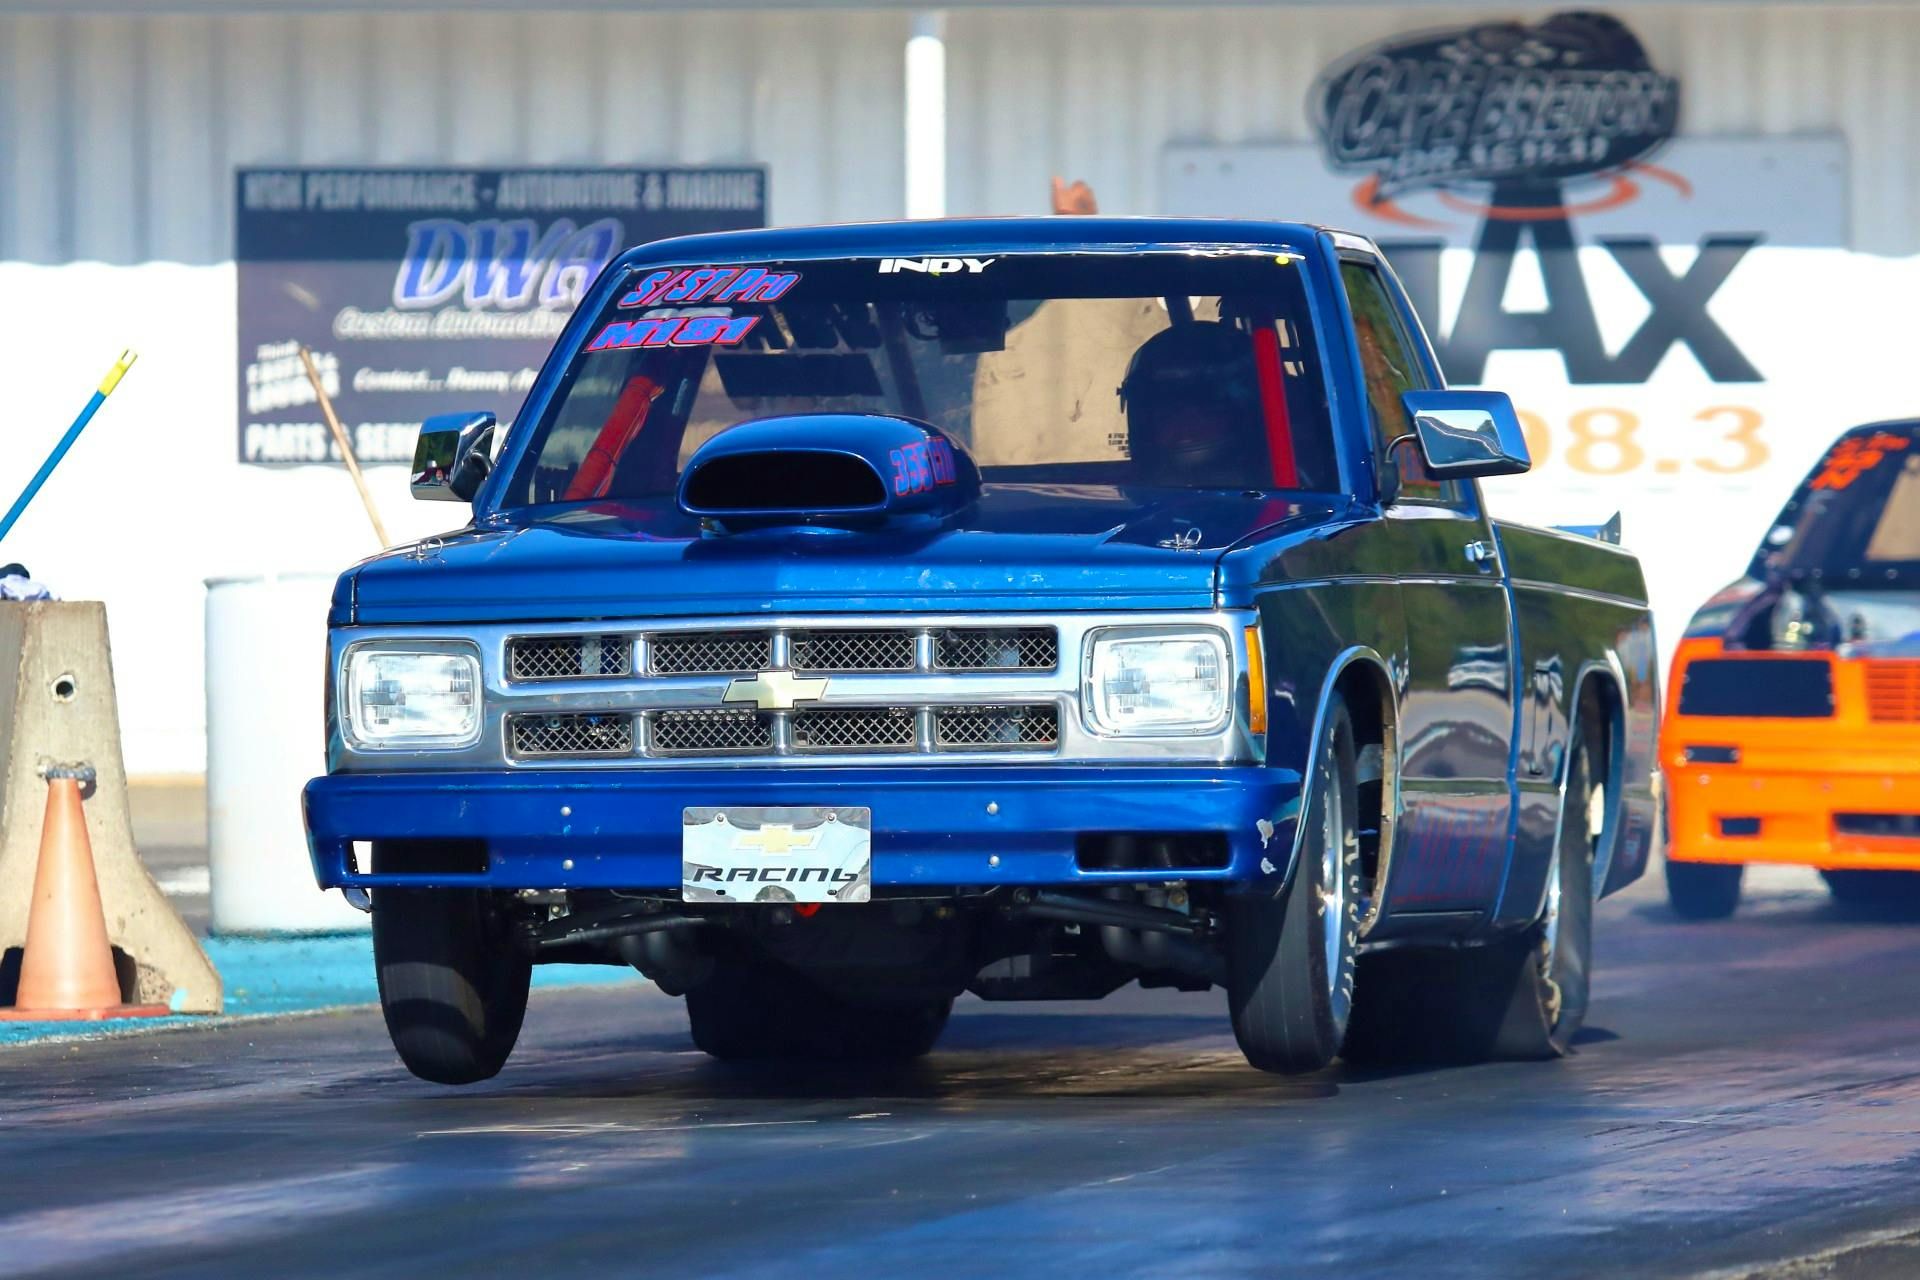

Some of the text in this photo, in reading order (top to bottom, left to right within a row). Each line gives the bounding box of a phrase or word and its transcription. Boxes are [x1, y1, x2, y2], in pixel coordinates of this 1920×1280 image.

[305, 172, 477, 210] PERFORMANCE
[393, 218, 624, 309] DWA
[878, 258, 996, 273] INDY
[712, 267, 800, 302] Pro
[585, 316, 761, 352] M181
[245, 423, 326, 461] PARTS
[692, 867, 859, 882] RACING
